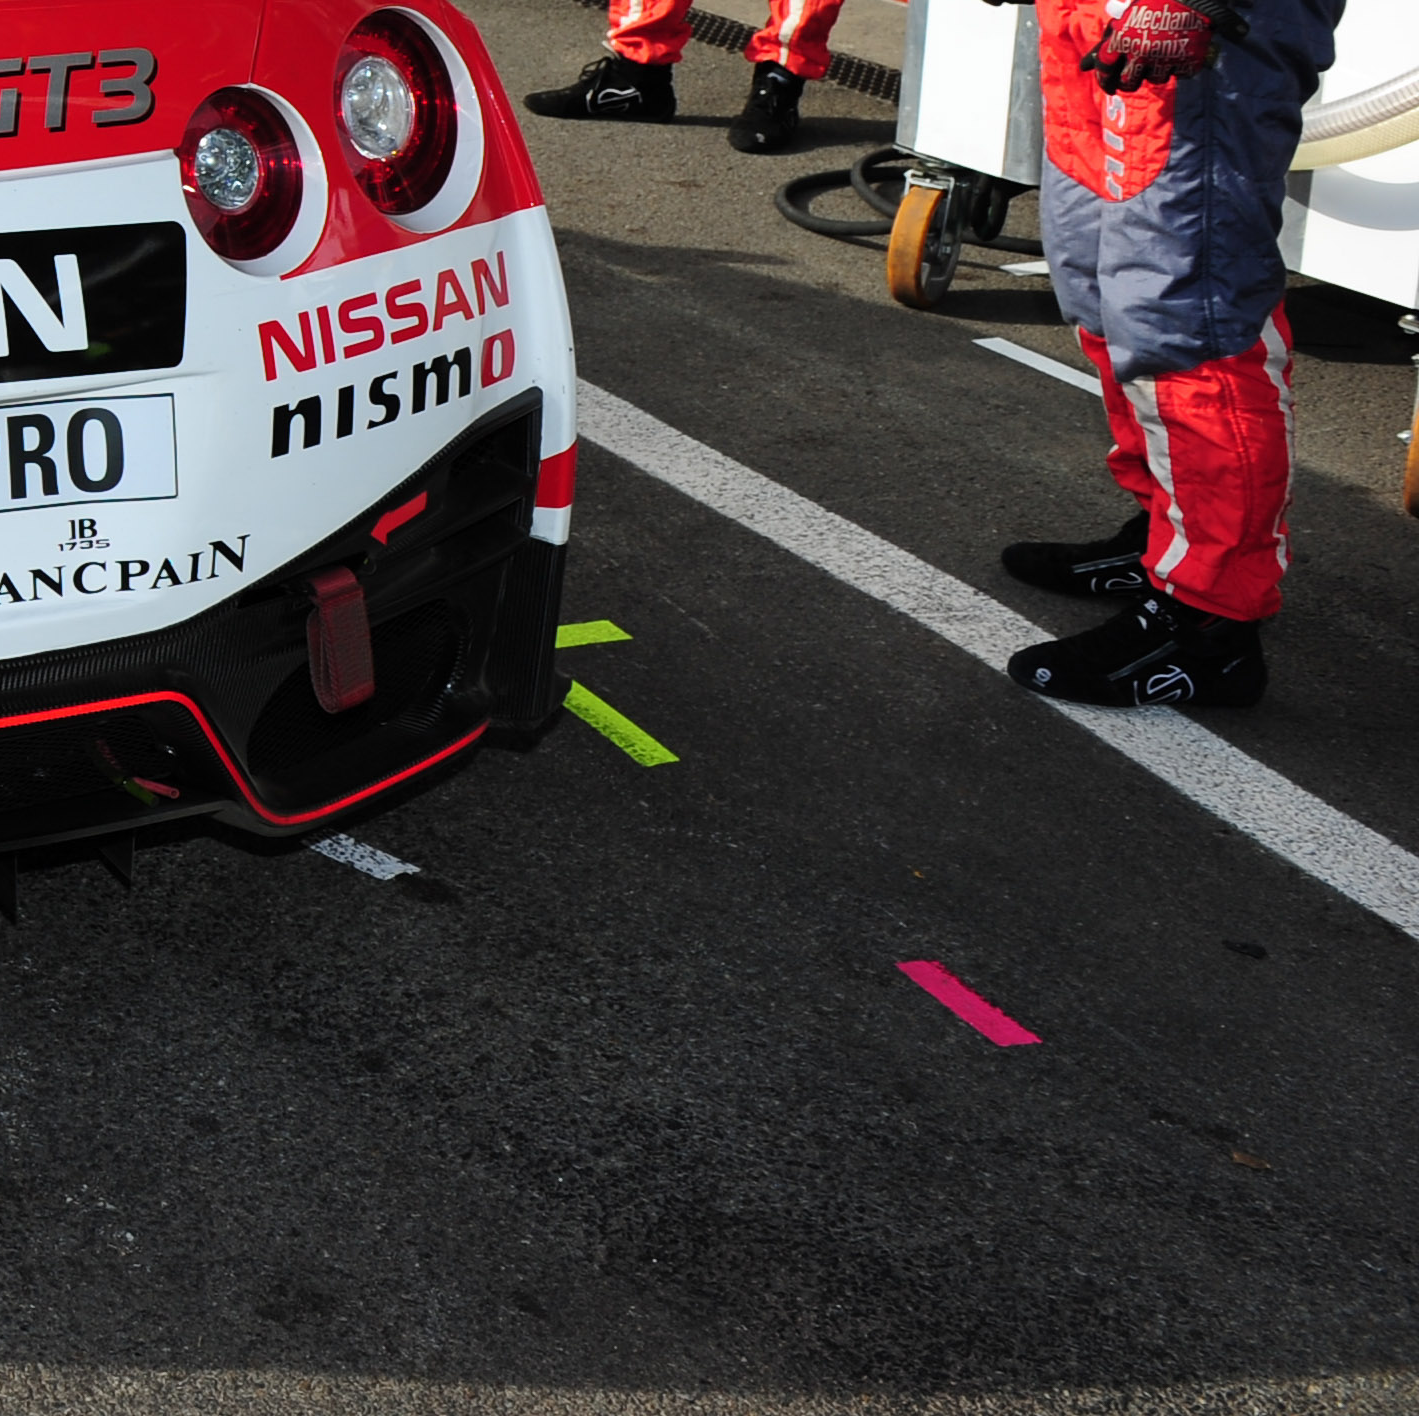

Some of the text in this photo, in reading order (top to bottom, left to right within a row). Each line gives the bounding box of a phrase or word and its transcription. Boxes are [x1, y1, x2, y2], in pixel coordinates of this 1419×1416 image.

[258, 250, 510, 382] NISSAN
[271, 328, 516, 459] nismo
[56, 537, 111, 552] 1735
